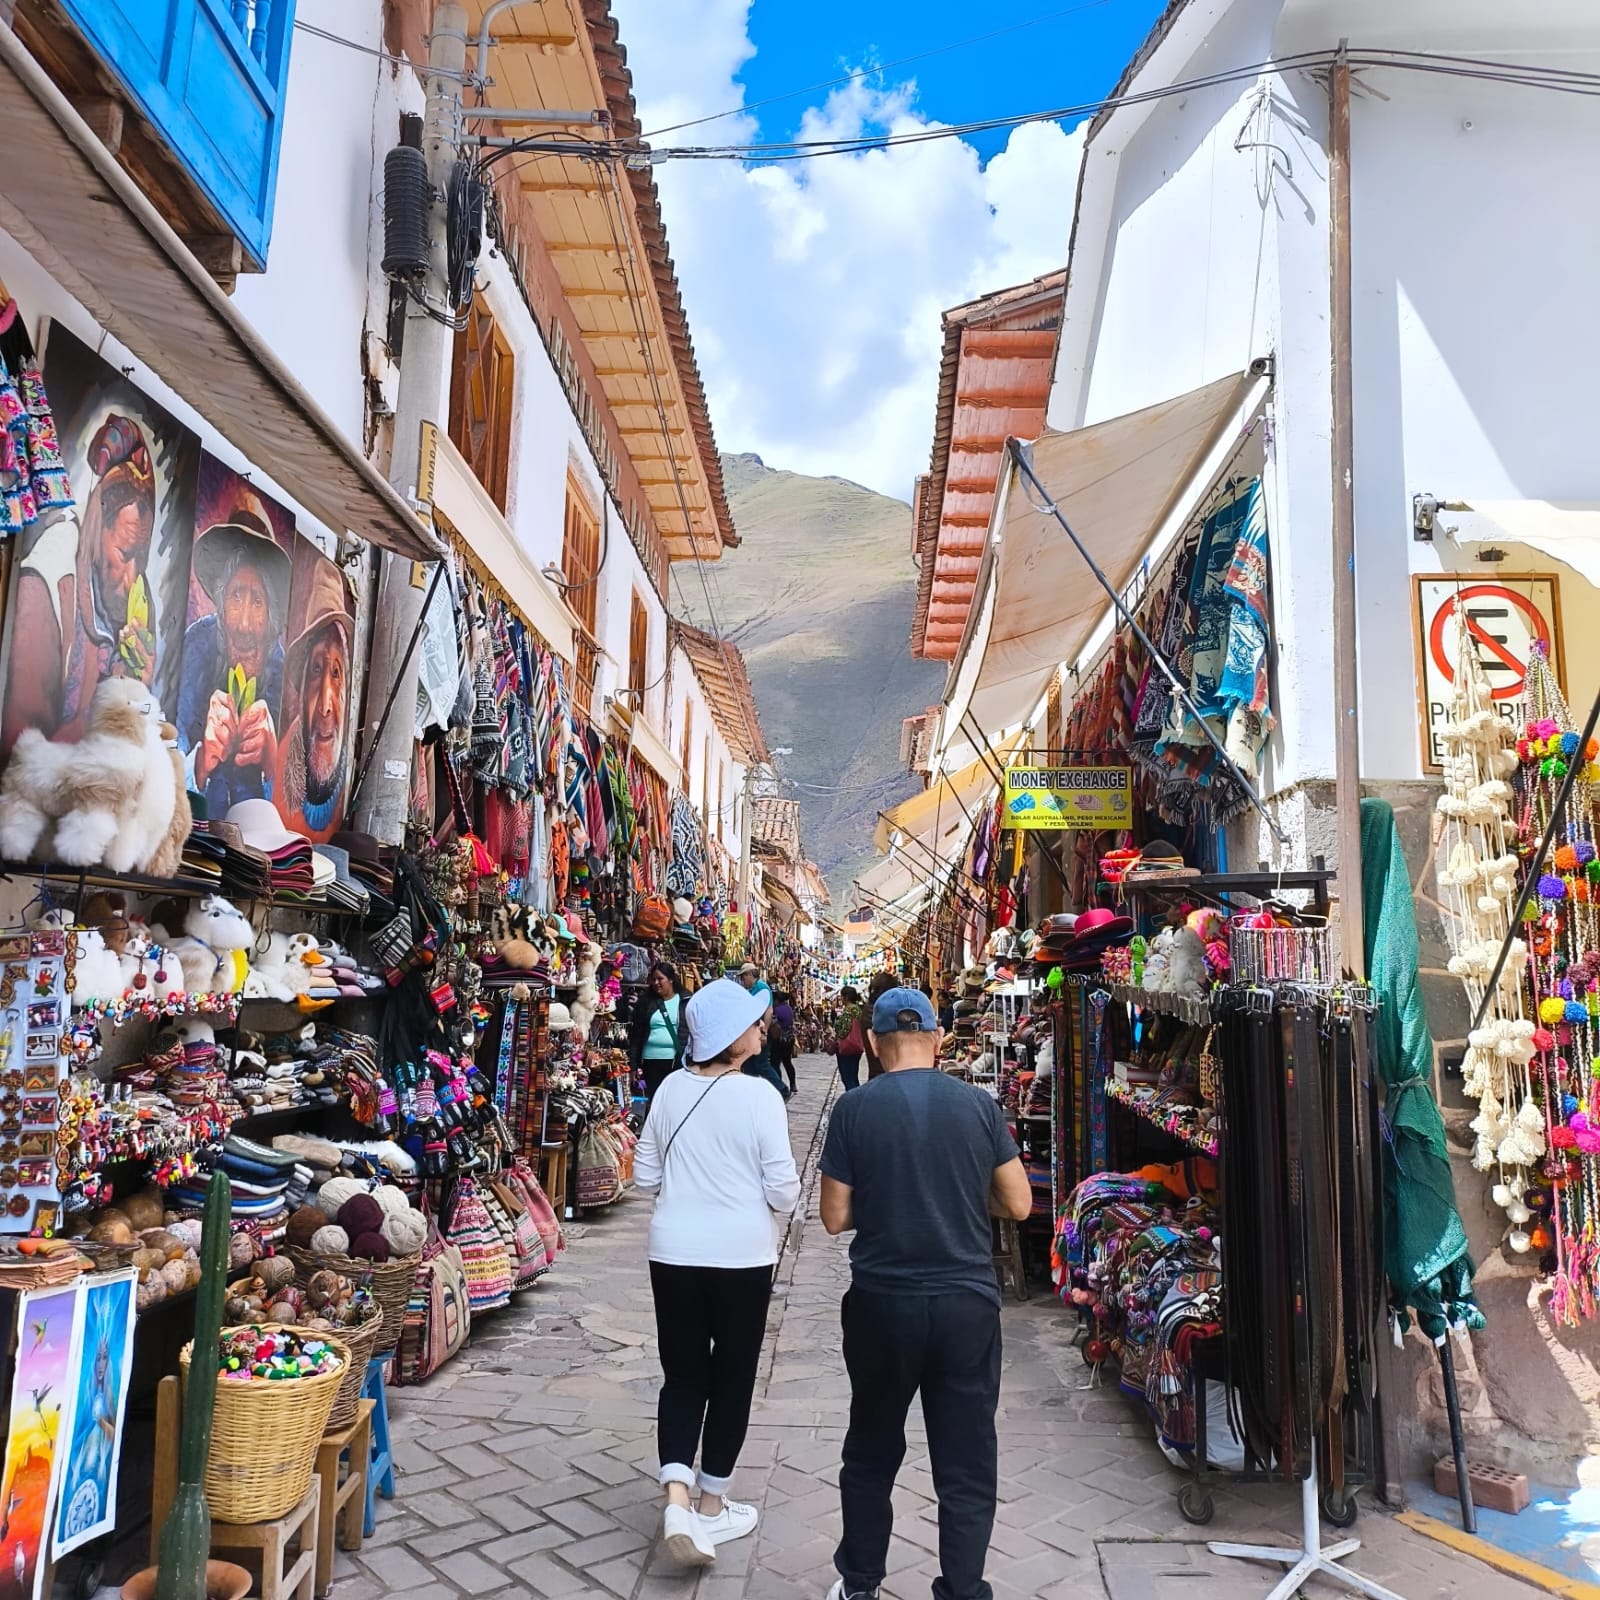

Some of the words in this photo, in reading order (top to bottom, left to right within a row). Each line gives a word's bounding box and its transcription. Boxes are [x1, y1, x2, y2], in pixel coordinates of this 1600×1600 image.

[1467, 608, 1512, 671] E
[1010, 770, 1056, 789] MONEY
[1057, 770, 1127, 789] EXCHANGE
